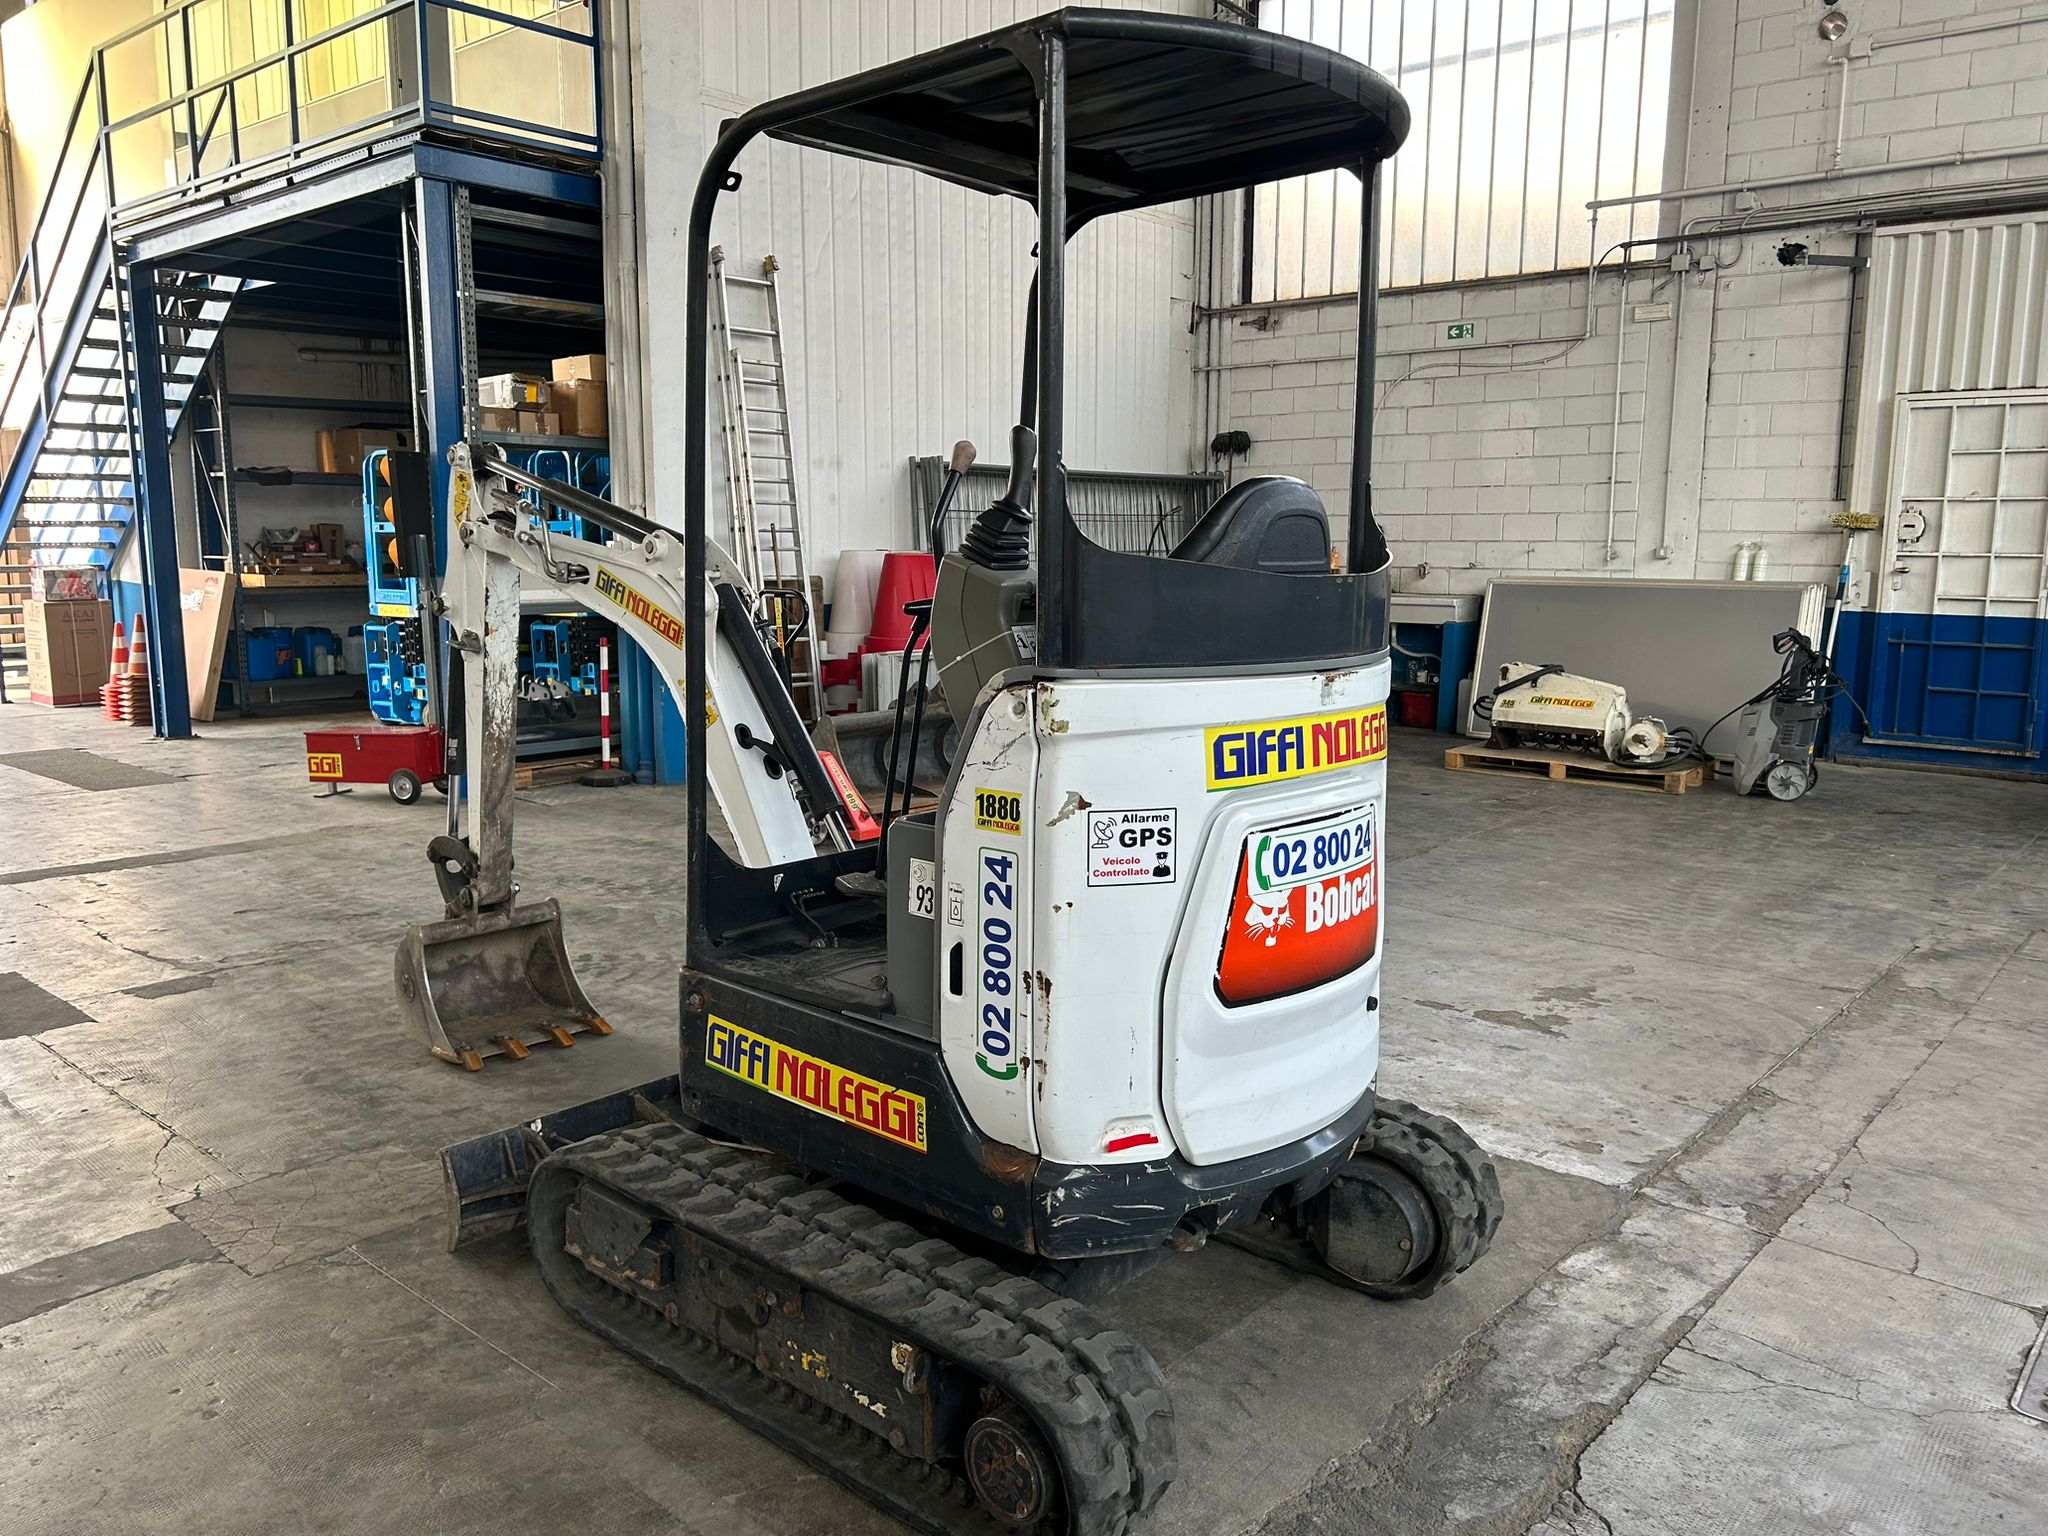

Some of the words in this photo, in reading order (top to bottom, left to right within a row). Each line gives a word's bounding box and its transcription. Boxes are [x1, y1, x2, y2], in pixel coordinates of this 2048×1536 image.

[63, 609, 95, 619] AKAI
[595, 569, 626, 605] GIFFI
[626, 590, 682, 645] NOLEGGI
[1530, 695, 1553, 705] GIFFI
[1552, 698, 1593, 708] NOLEGGI
[1213, 725, 1305, 780] GIFFI
[975, 793, 1021, 823] 1880
[978, 818, 992, 827] GIFFI
[1121, 813, 1170, 824] Allarme
[1119, 826, 1172, 848] GPS
[1273, 839, 1307, 878] 02
[1313, 828, 1351, 870] 800
[1354, 819, 1371, 858] 24
[1092, 868, 1150, 878] Controllato
[1102, 856, 1141, 866] Veicolo
[984, 855, 1013, 911] 24
[1305, 862, 1375, 933] Bobcat
[916, 884, 934, 915] 93
[982, 917, 1012, 997] 800
[982, 1003, 1011, 1058] 02
[707, 1021, 771, 1086] GIFFI
[776, 1049, 917, 1144] NOLEGGI
